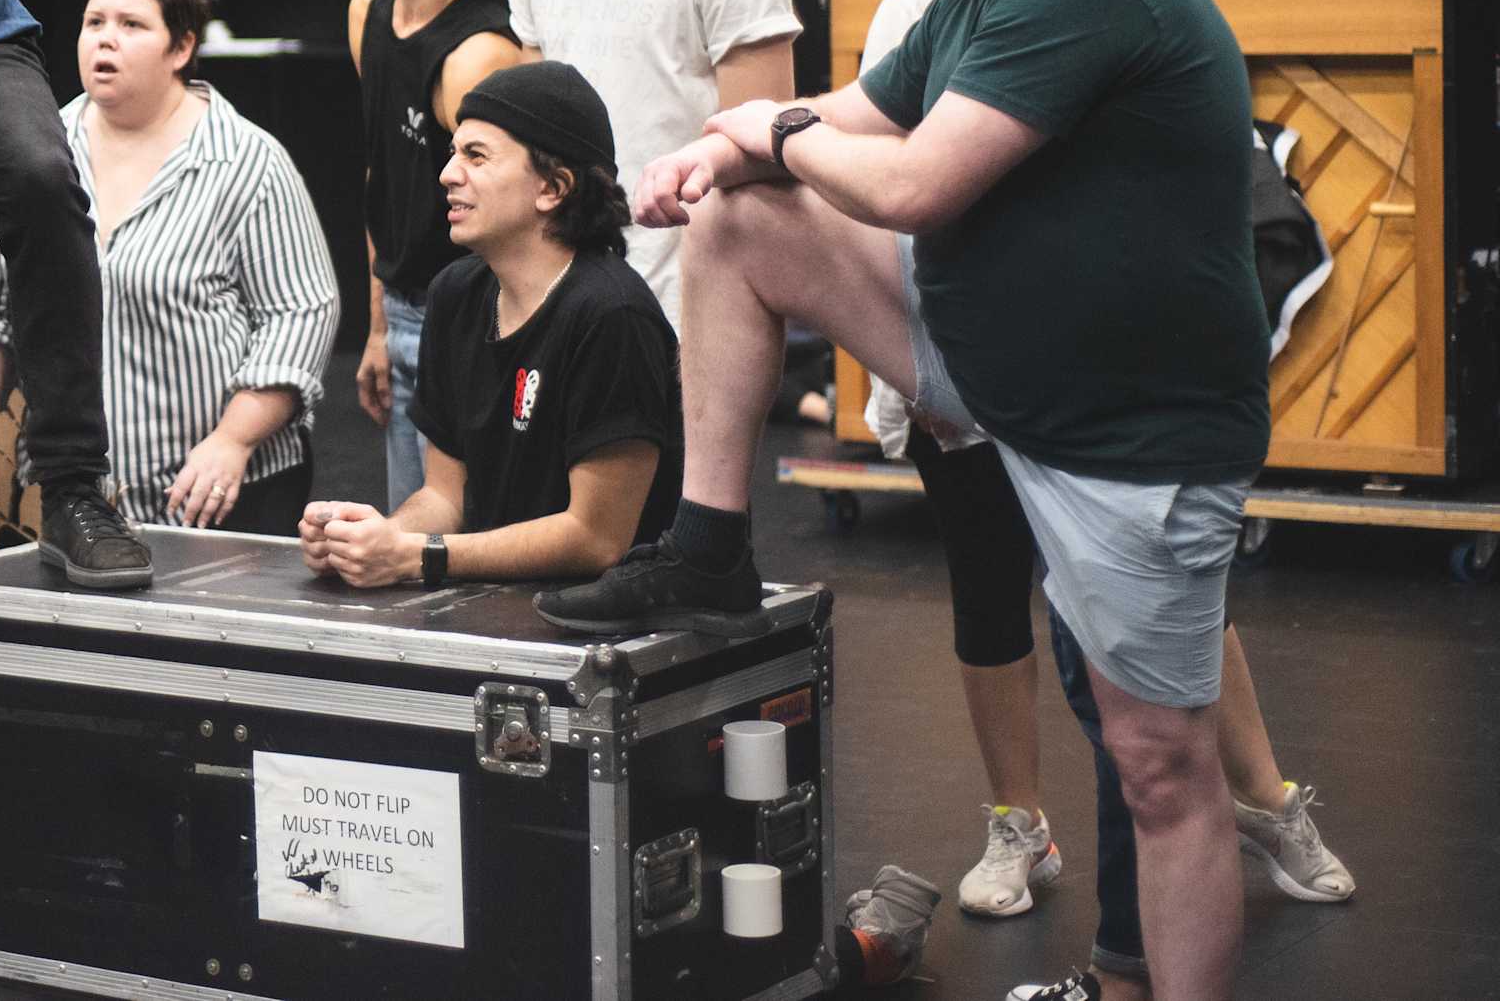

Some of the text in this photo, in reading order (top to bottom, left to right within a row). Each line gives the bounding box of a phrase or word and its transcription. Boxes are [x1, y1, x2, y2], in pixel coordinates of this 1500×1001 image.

[303, 786, 411, 814] DO NOT FLIP
[282, 814, 434, 848] MUST TRAVEL ON
[322, 849, 394, 874] WHEELS
